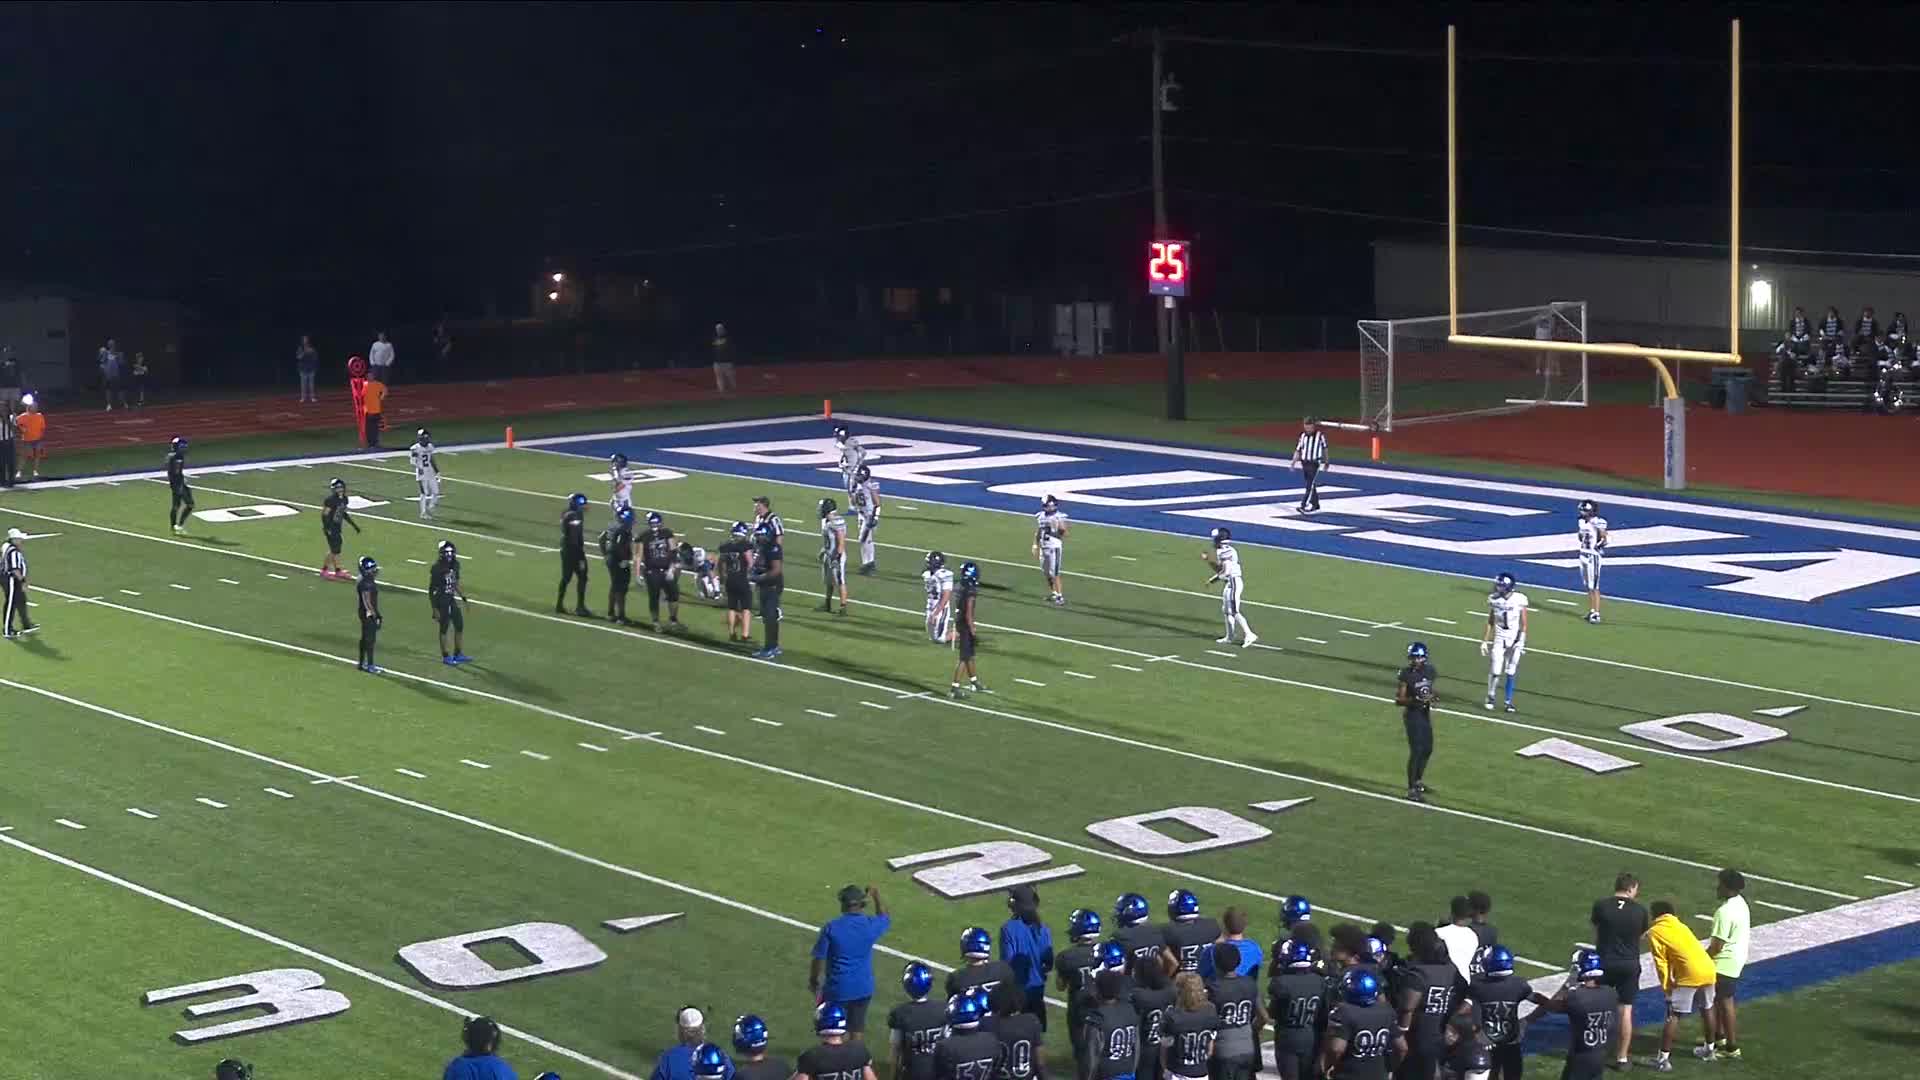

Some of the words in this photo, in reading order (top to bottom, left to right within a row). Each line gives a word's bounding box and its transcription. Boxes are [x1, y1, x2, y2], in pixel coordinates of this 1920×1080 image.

[1150, 242, 1183, 280] 25
[421, 454, 430, 468] 2
[656, 437, 1920, 617] BLUEJA
[1514, 712, 1789, 773] 10
[888, 804, 1272, 900] 20
[1617, 900, 1625, 910] 7
[145, 920, 608, 1044] 30
